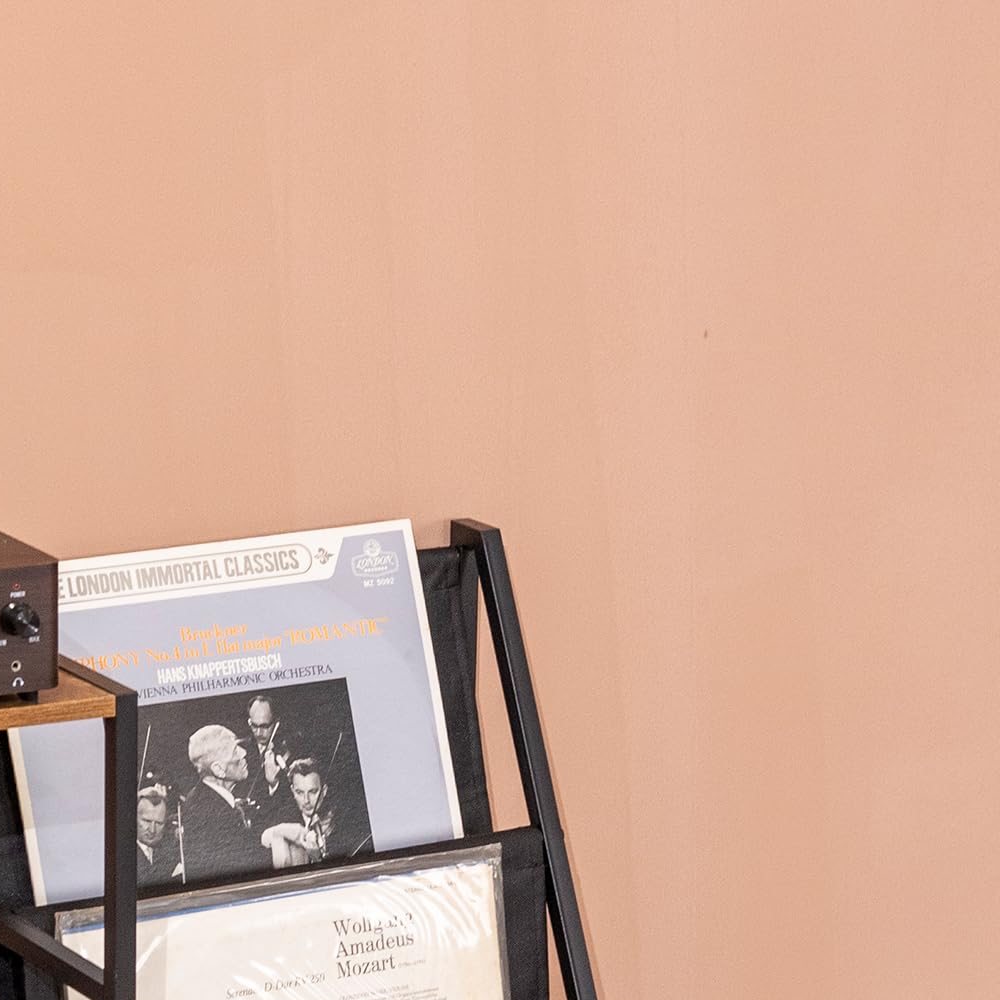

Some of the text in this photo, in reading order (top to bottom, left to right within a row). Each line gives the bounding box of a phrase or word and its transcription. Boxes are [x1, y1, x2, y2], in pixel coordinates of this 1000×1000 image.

[67, 570, 133, 598] LONDON
[135, 560, 221, 589] IMMORTAL
[224, 549, 300, 578] CLASSICS
[137, 664, 334, 699] VIENNA PHILHARMONIC ORCHESTRA
[157, 652, 282, 685] HANS KNAPPERTSBUSCH
[335, 932, 415, 959] Amadeus
[336, 954, 397, 980] Mozart
